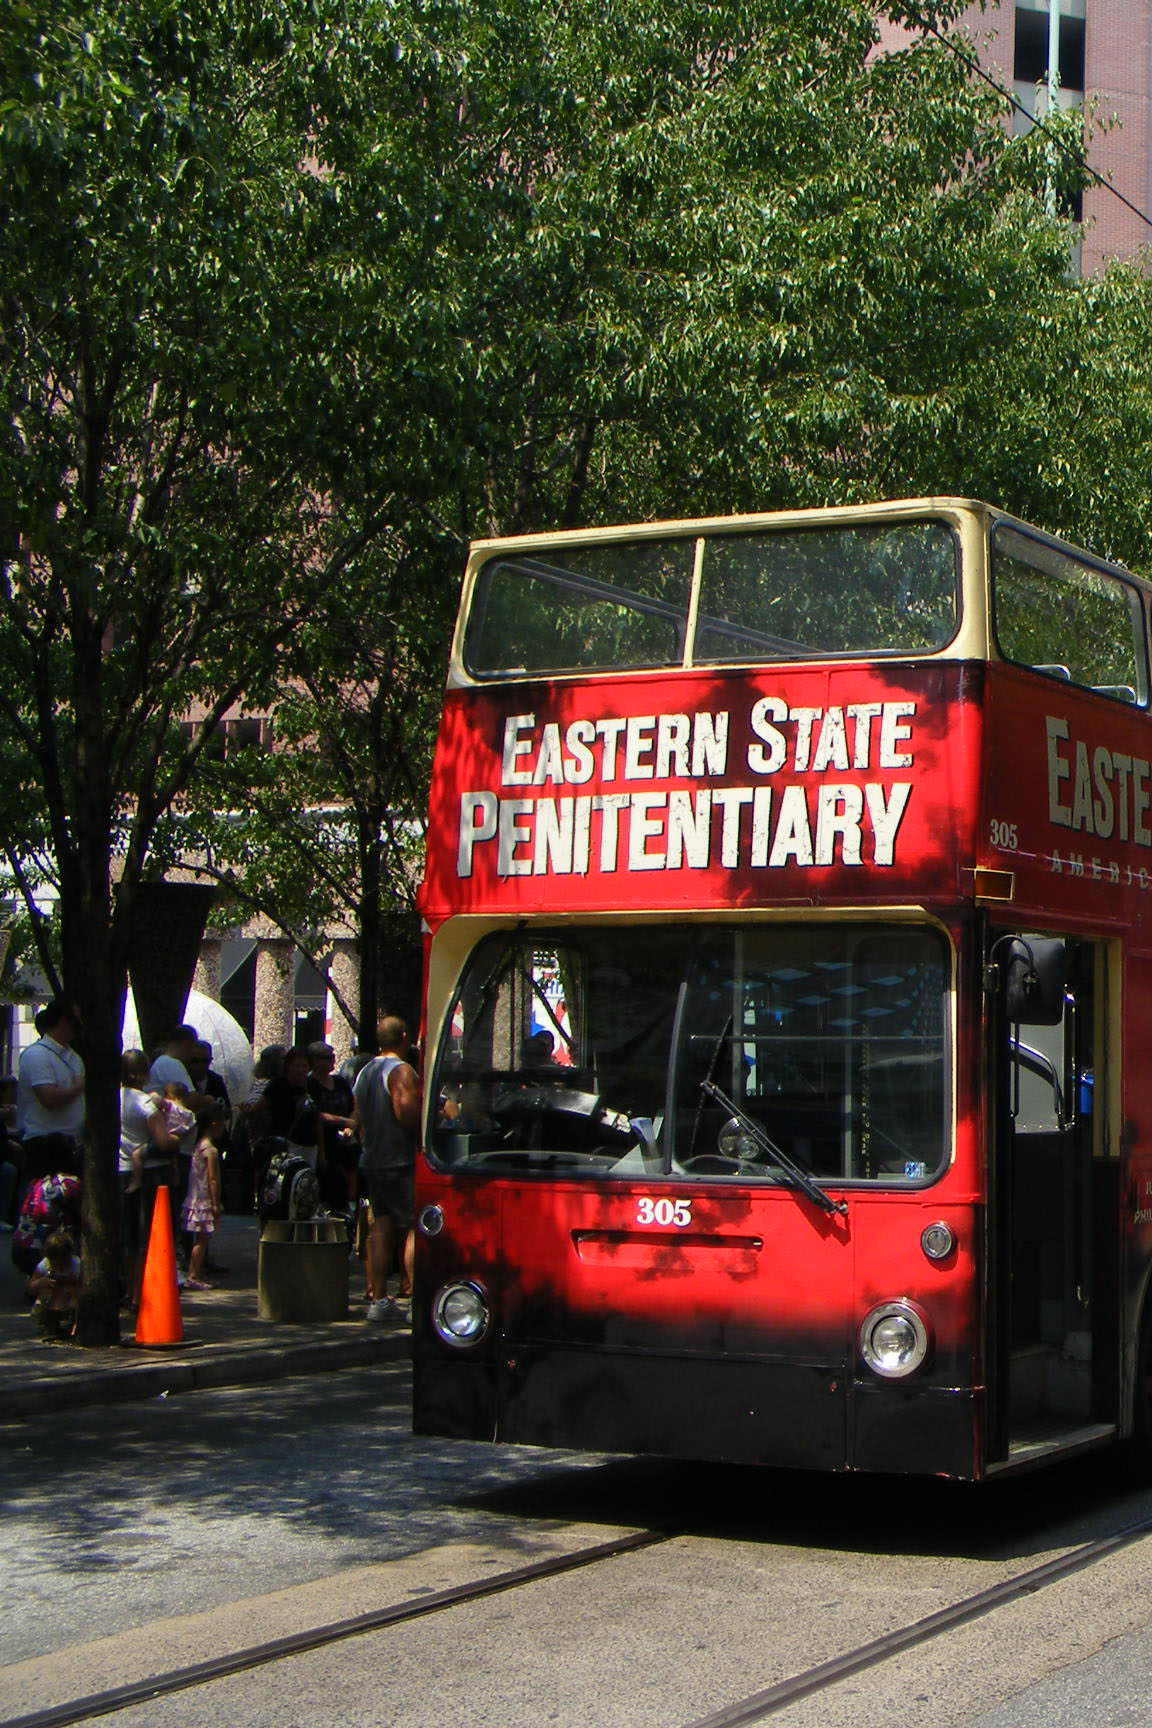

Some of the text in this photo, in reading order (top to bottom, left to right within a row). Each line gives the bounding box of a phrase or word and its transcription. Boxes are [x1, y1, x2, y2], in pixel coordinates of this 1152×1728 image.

[501, 696, 917, 787] EASTERN STATE
[456, 783, 913, 879] PENITENTIARY
[990, 819, 1018, 849] 305
[636, 1198, 692, 1227] 305
